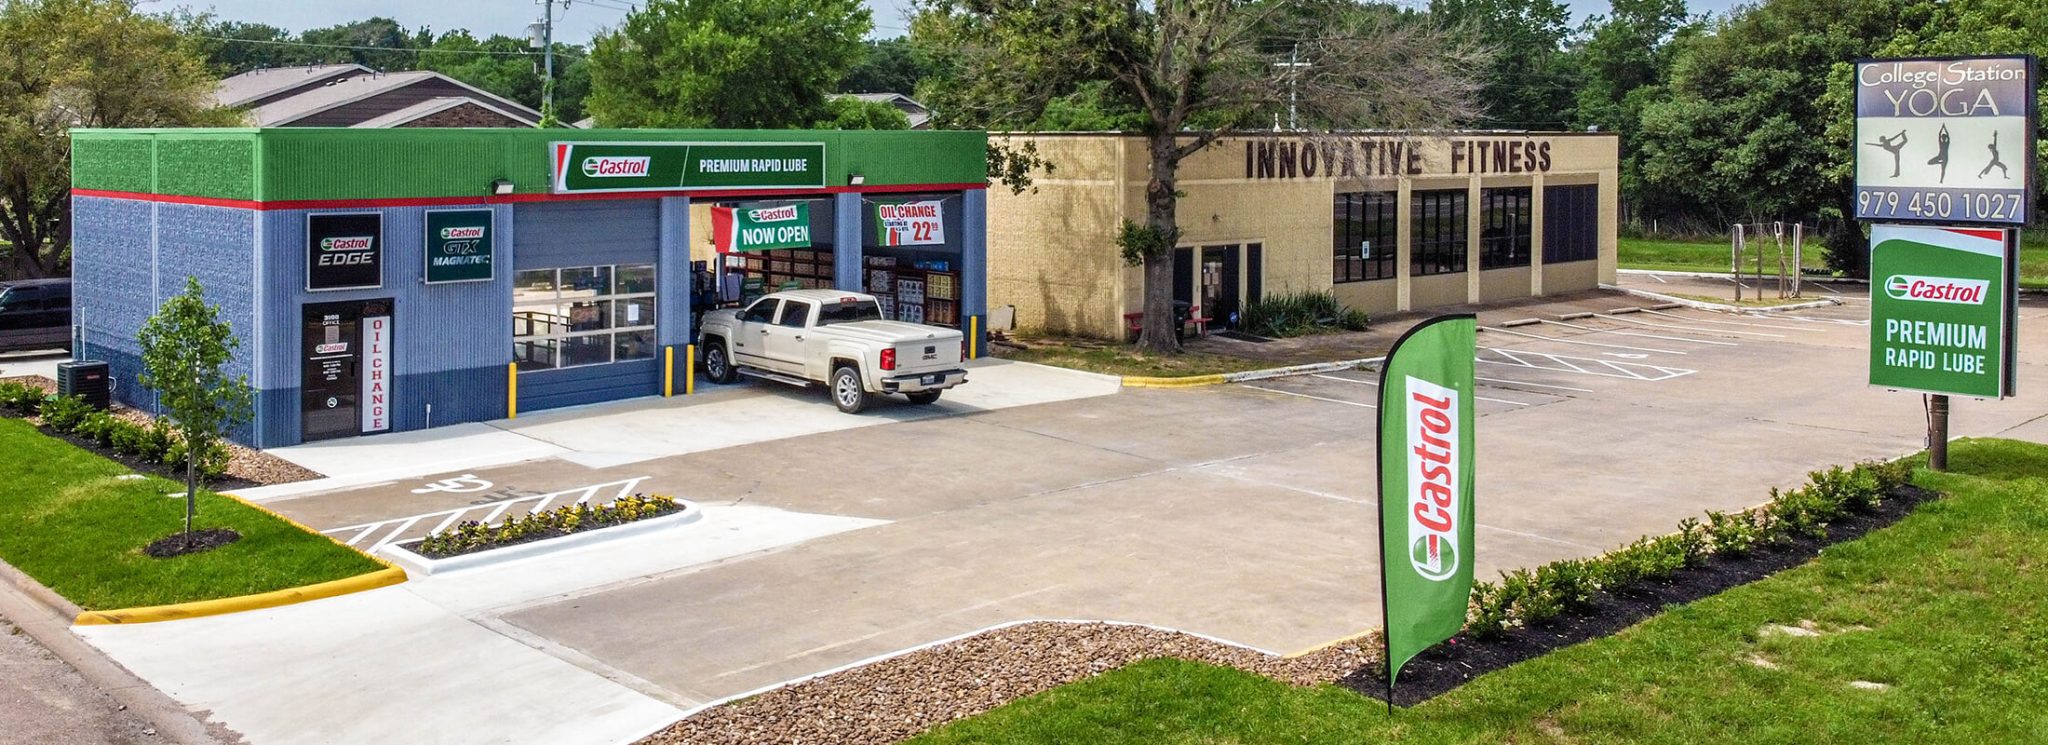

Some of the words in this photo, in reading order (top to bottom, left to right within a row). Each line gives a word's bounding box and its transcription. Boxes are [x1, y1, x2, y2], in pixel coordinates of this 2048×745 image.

[1859, 63, 1938, 89] College
[1943, 62, 2026, 85] Station
[1884, 88, 1999, 117] YOGA
[600, 159, 646, 175] Castrol
[699, 159, 750, 173] PREMIUM
[751, 159, 781, 172] RAPID
[782, 158, 808, 172] LUBE
[1246, 140, 1422, 178] INNOVATIVE
[1451, 140, 1551, 174] FITNESS
[761, 207, 795, 221] Castrol
[880, 206, 896, 218] OIL
[897, 205, 937, 218] CHANGE
[1859, 190, 1899, 216] 979
[1908, 191, 1952, 218] 450
[1963, 193, 2021, 219] 1027
[451, 229, 481, 237] Castrol
[742, 227, 775, 245] NOW
[777, 226, 809, 243] OPEN
[912, 221, 932, 241] 22
[333, 238, 369, 249] Castrol
[443, 240, 480, 255] GTX
[318, 252, 375, 266] EDGE
[432, 255, 490, 266] MAGNATEC
[1910, 280, 1981, 302] Castrol
[372, 319, 383, 354] OIL
[1886, 318, 1987, 350] PREMIUM
[1885, 347, 1936, 370] RAPID
[1943, 352, 1986, 375] LUBE
[371, 358, 384, 429] CHANGE
[1412, 391, 1453, 533] Castrol
